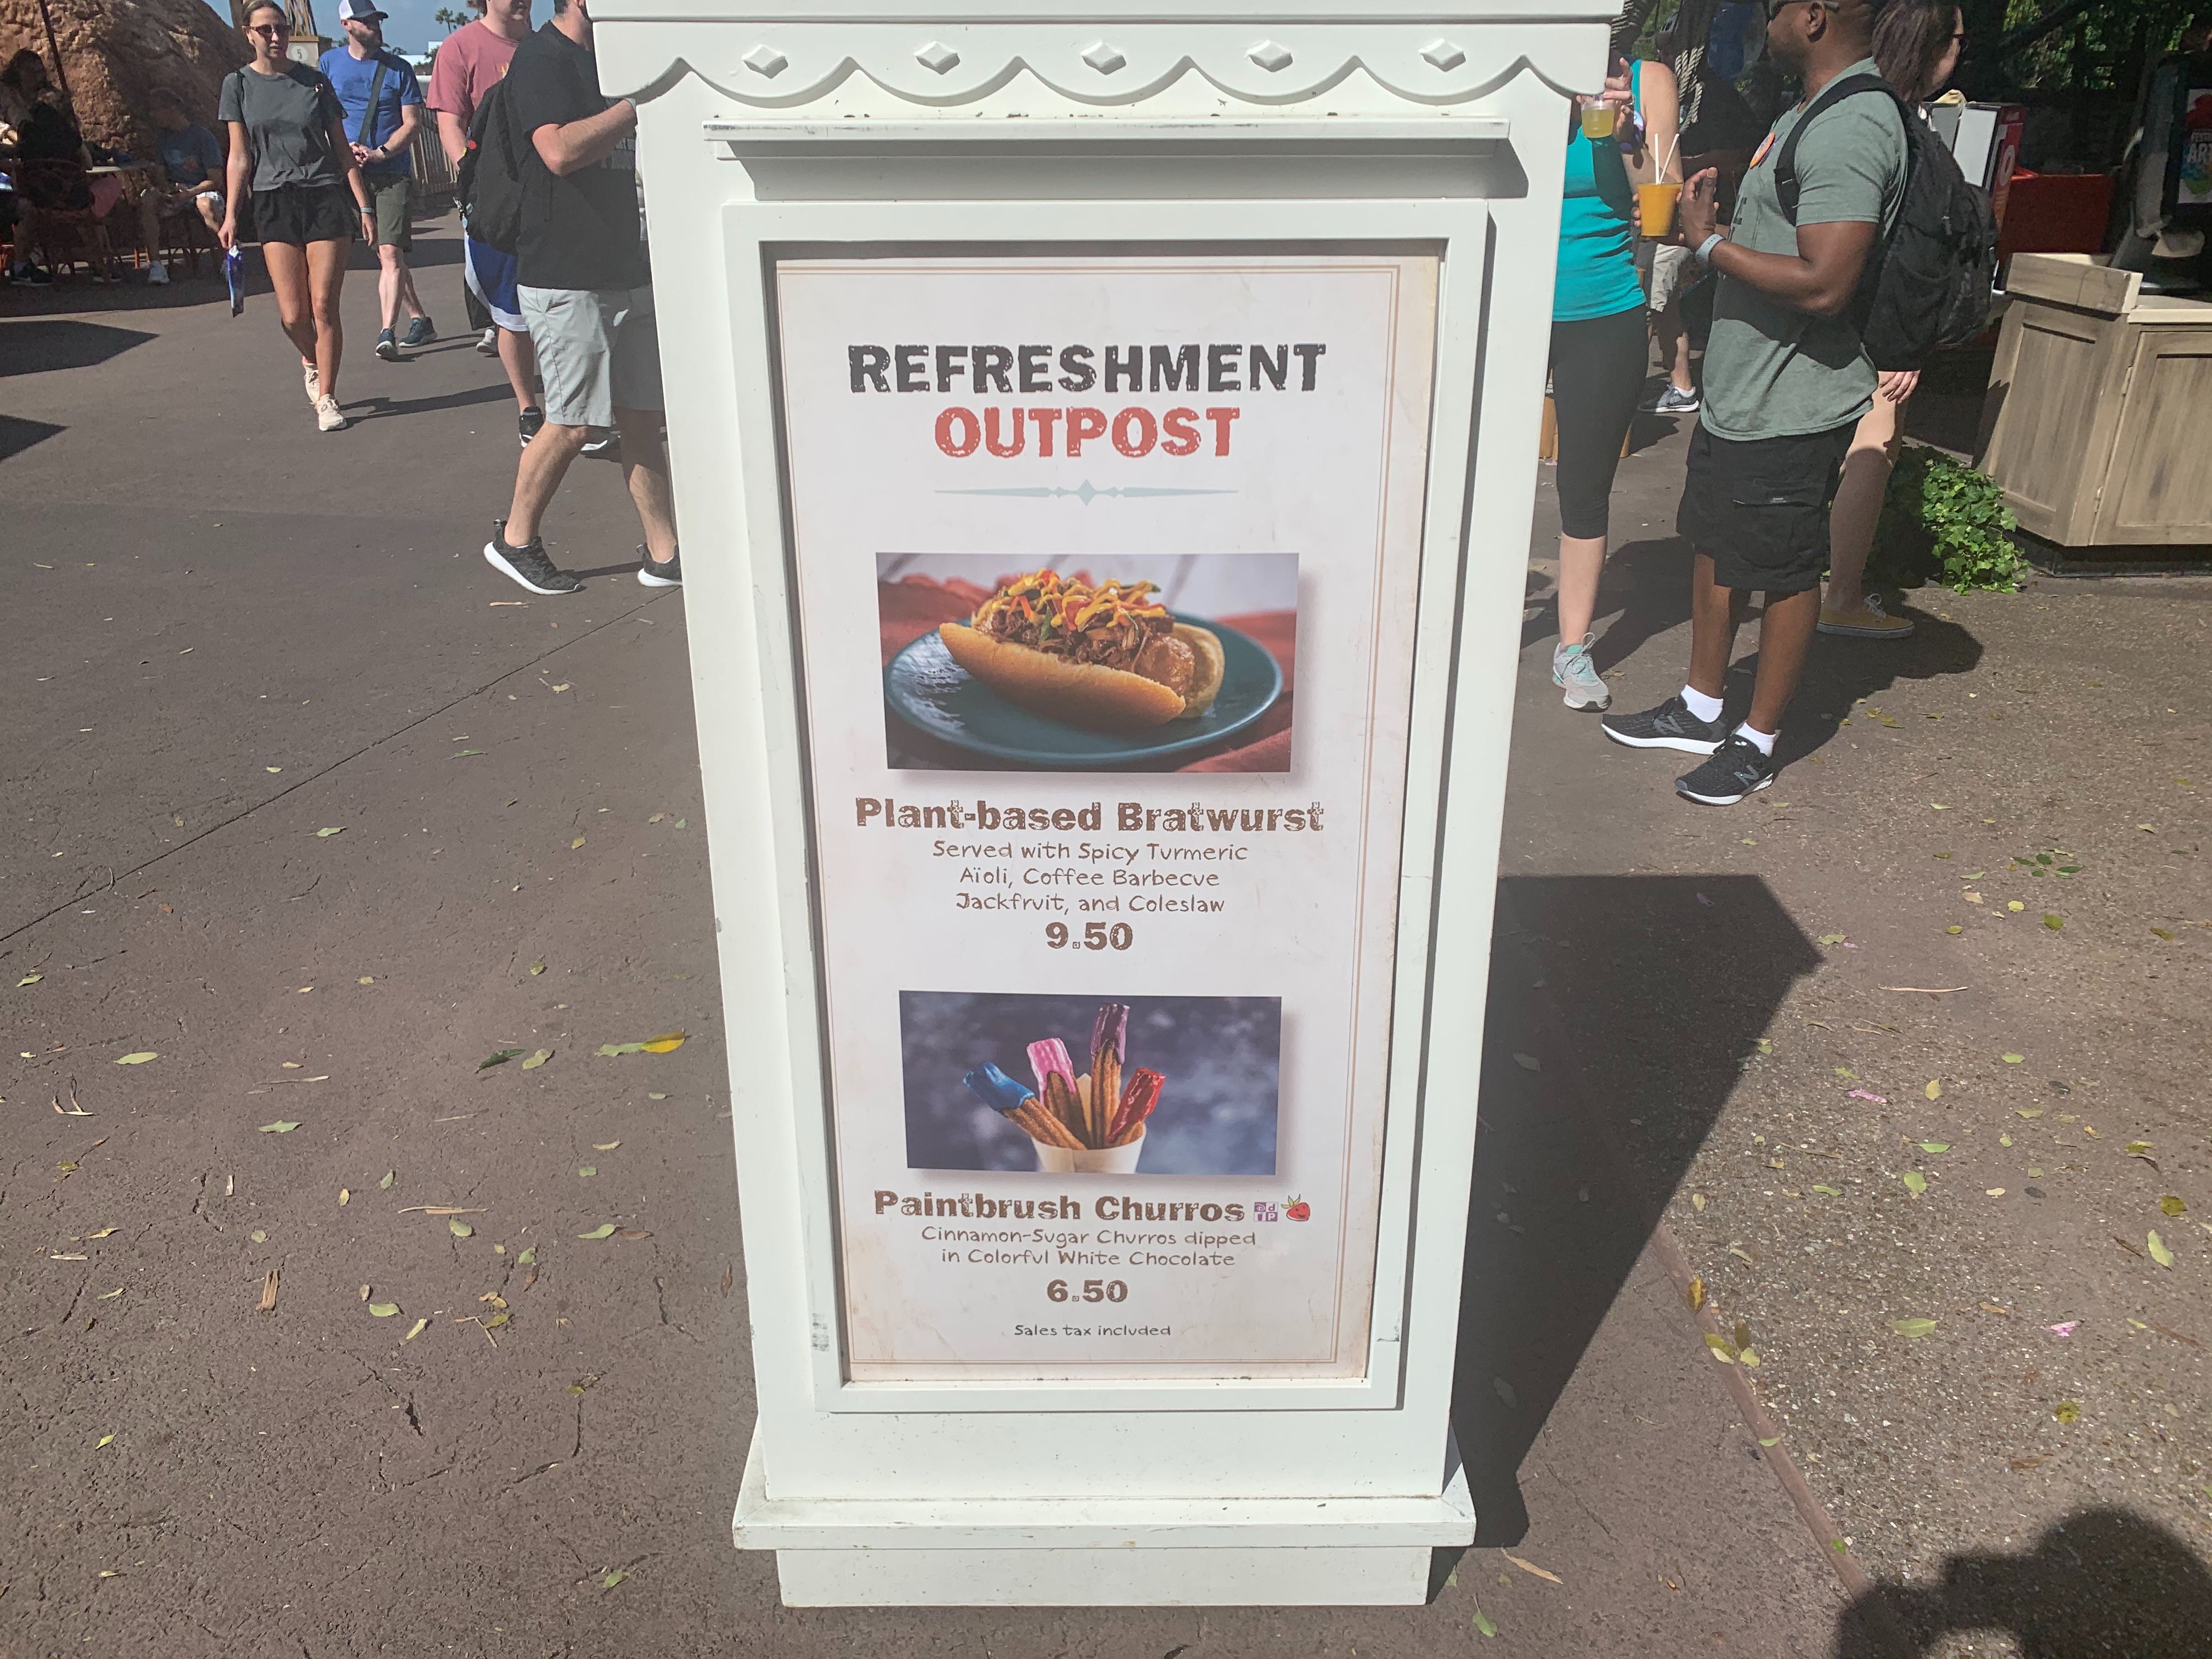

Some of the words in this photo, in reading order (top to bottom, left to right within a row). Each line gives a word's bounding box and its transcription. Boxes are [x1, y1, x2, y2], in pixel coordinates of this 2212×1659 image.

[848, 343, 1326, 393] REFRESHMENT
[935, 407, 1240, 458] OUTPOST
[856, 797, 1101, 831] Plant-based
[1118, 802, 1324, 832] Bratwurst
[933, 840, 1012, 858] Served
[1021, 842, 1070, 859] with
[1078, 843, 1139, 866] Spicy
[1147, 843, 1249, 860] Turmeric
[960, 866, 1013, 889] Aïoli,
[1023, 868, 1104, 885] Coffee
[1113, 869, 1219, 887] Barbecue
[956, 893, 1069, 915] Jackfruit,
[1079, 895, 1119, 911] and
[1129, 894, 1224, 913] Coleslaw
[1046, 922, 1133, 951] 9.50
[874, 1190, 1081, 1220] Paintbrush
[1096, 1196, 1245, 1221] Churros
[922, 1226, 1089, 1249] Cinnamon-Sugar
[1097, 1230, 1176, 1244] Churros
[1184, 1231, 1255, 1248] dipped
[943, 1249, 960, 1262] in
[968, 1249, 1048, 1264] Colorful
[1058, 1250, 1120, 1265] White
[1130, 1251, 1235, 1266] Chocolate
[1047, 1279, 1128, 1302] 6.50
[1014, 1324, 1057, 1336] Sales
[1062, 1324, 1091, 1336] tax
[1098, 1324, 1170, 1336] included
